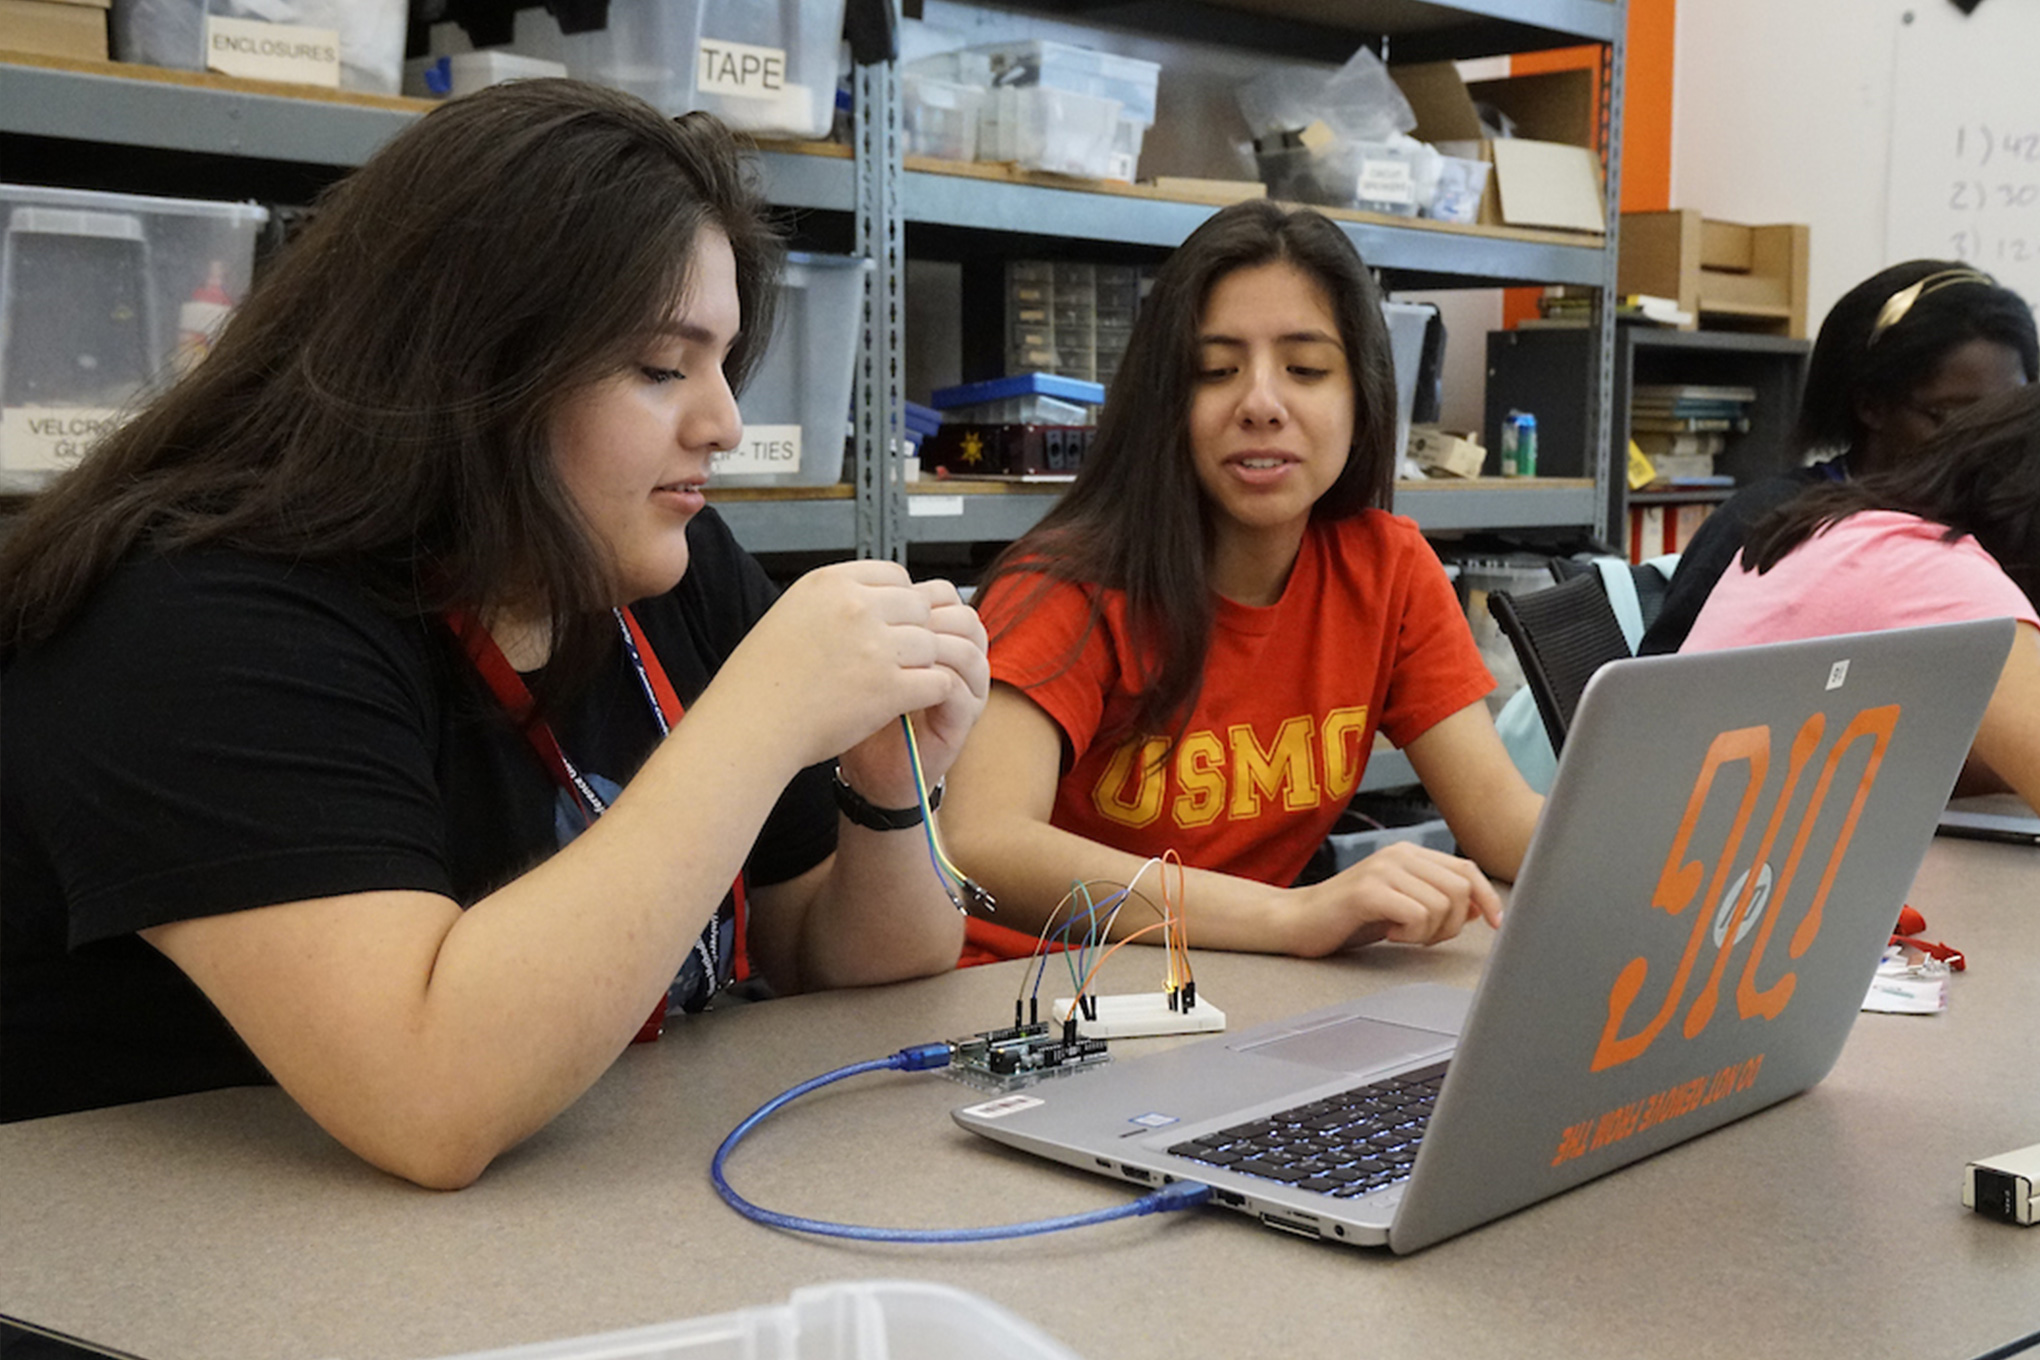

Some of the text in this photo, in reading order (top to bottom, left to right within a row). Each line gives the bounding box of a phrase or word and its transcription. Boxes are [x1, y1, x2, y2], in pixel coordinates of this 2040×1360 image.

[213, 33, 336, 64] ENCLOSURES
[701, 47, 782, 90] TAPE
[752, 440, 794, 461] TIES
[1091, 704, 1369, 830] USMC
[1637, 1075, 1710, 1132] REMOVE
[1701, 1062, 1743, 1106] NOT
[1550, 1118, 1594, 1168] THE
[1589, 1099, 1645, 1151] FROM
